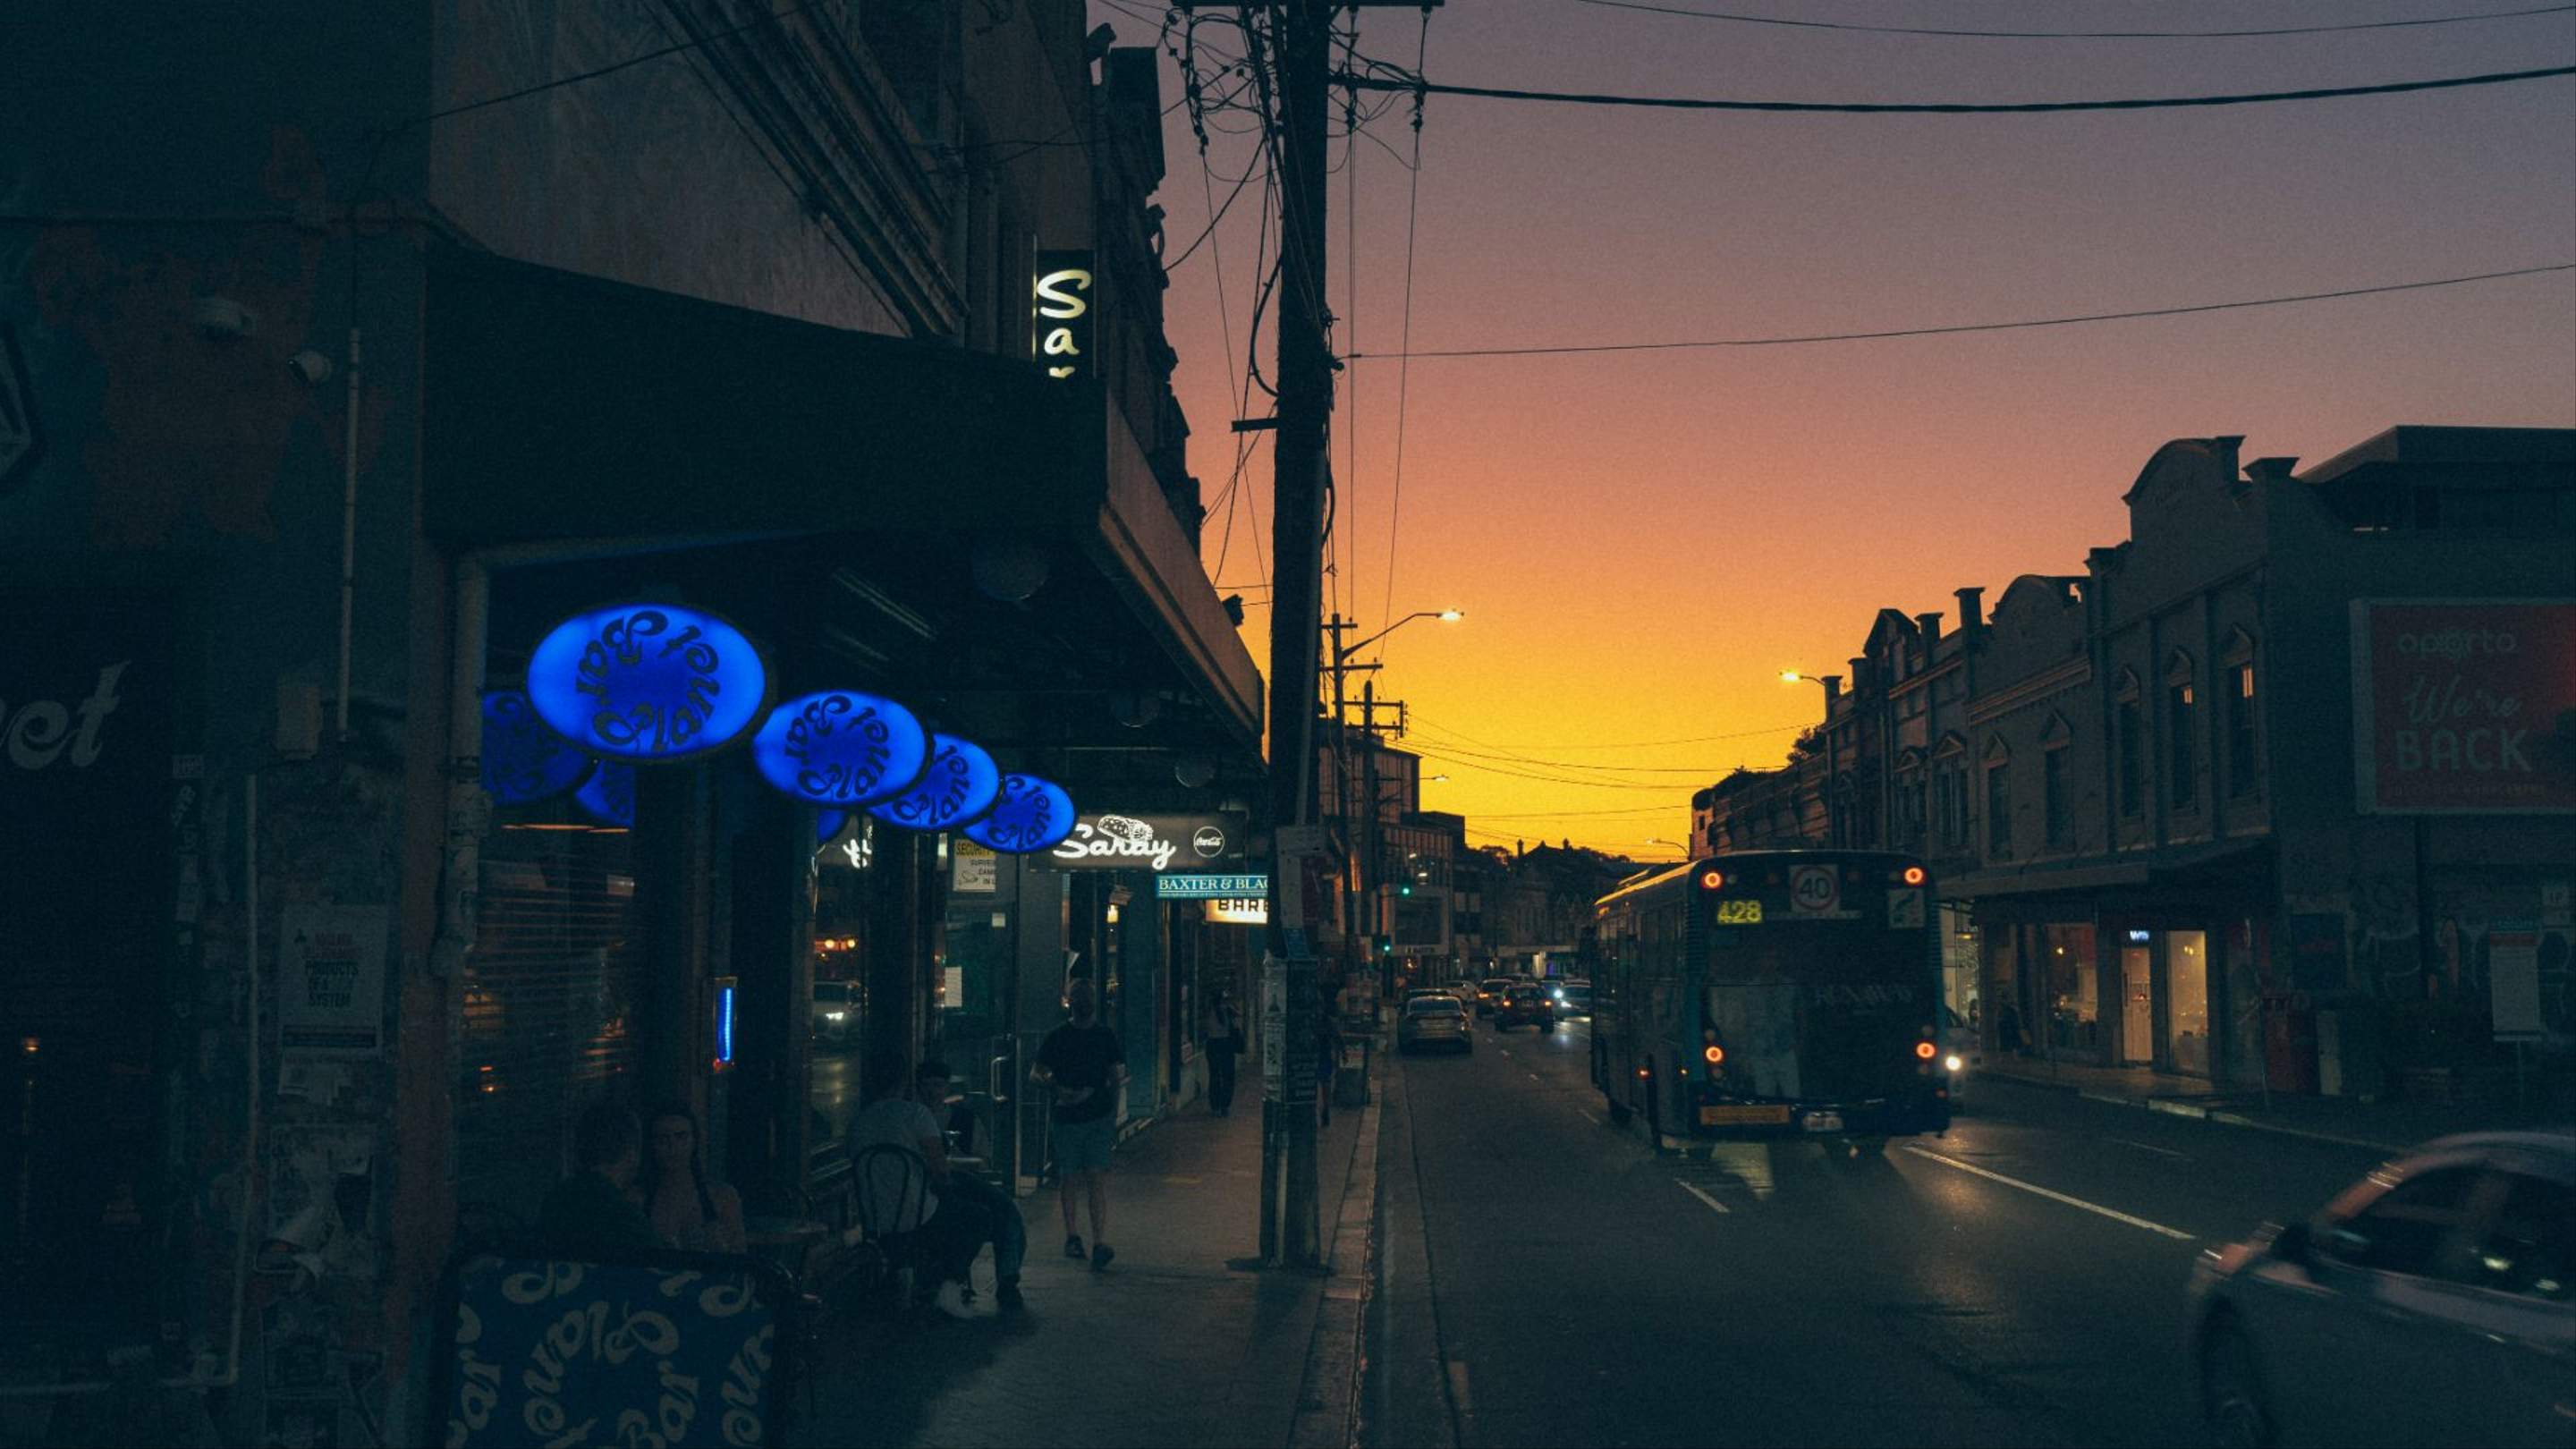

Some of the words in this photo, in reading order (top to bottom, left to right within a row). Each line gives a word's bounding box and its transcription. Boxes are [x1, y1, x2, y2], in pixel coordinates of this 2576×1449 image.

[2397, 629, 2517, 659] oporto
[2402, 674, 2522, 724] We're
[0, 659, 132, 771] et
[2395, 728, 2532, 773] BACK
[1053, 823, 1177, 870] Saray
[1158, 878, 1218, 890] BAXTER
[1220, 878, 1233, 890] &
[1798, 877, 1831, 899] 40
[1717, 900, 1762, 924] 428
[308, 992, 352, 1007] SYSTEM
